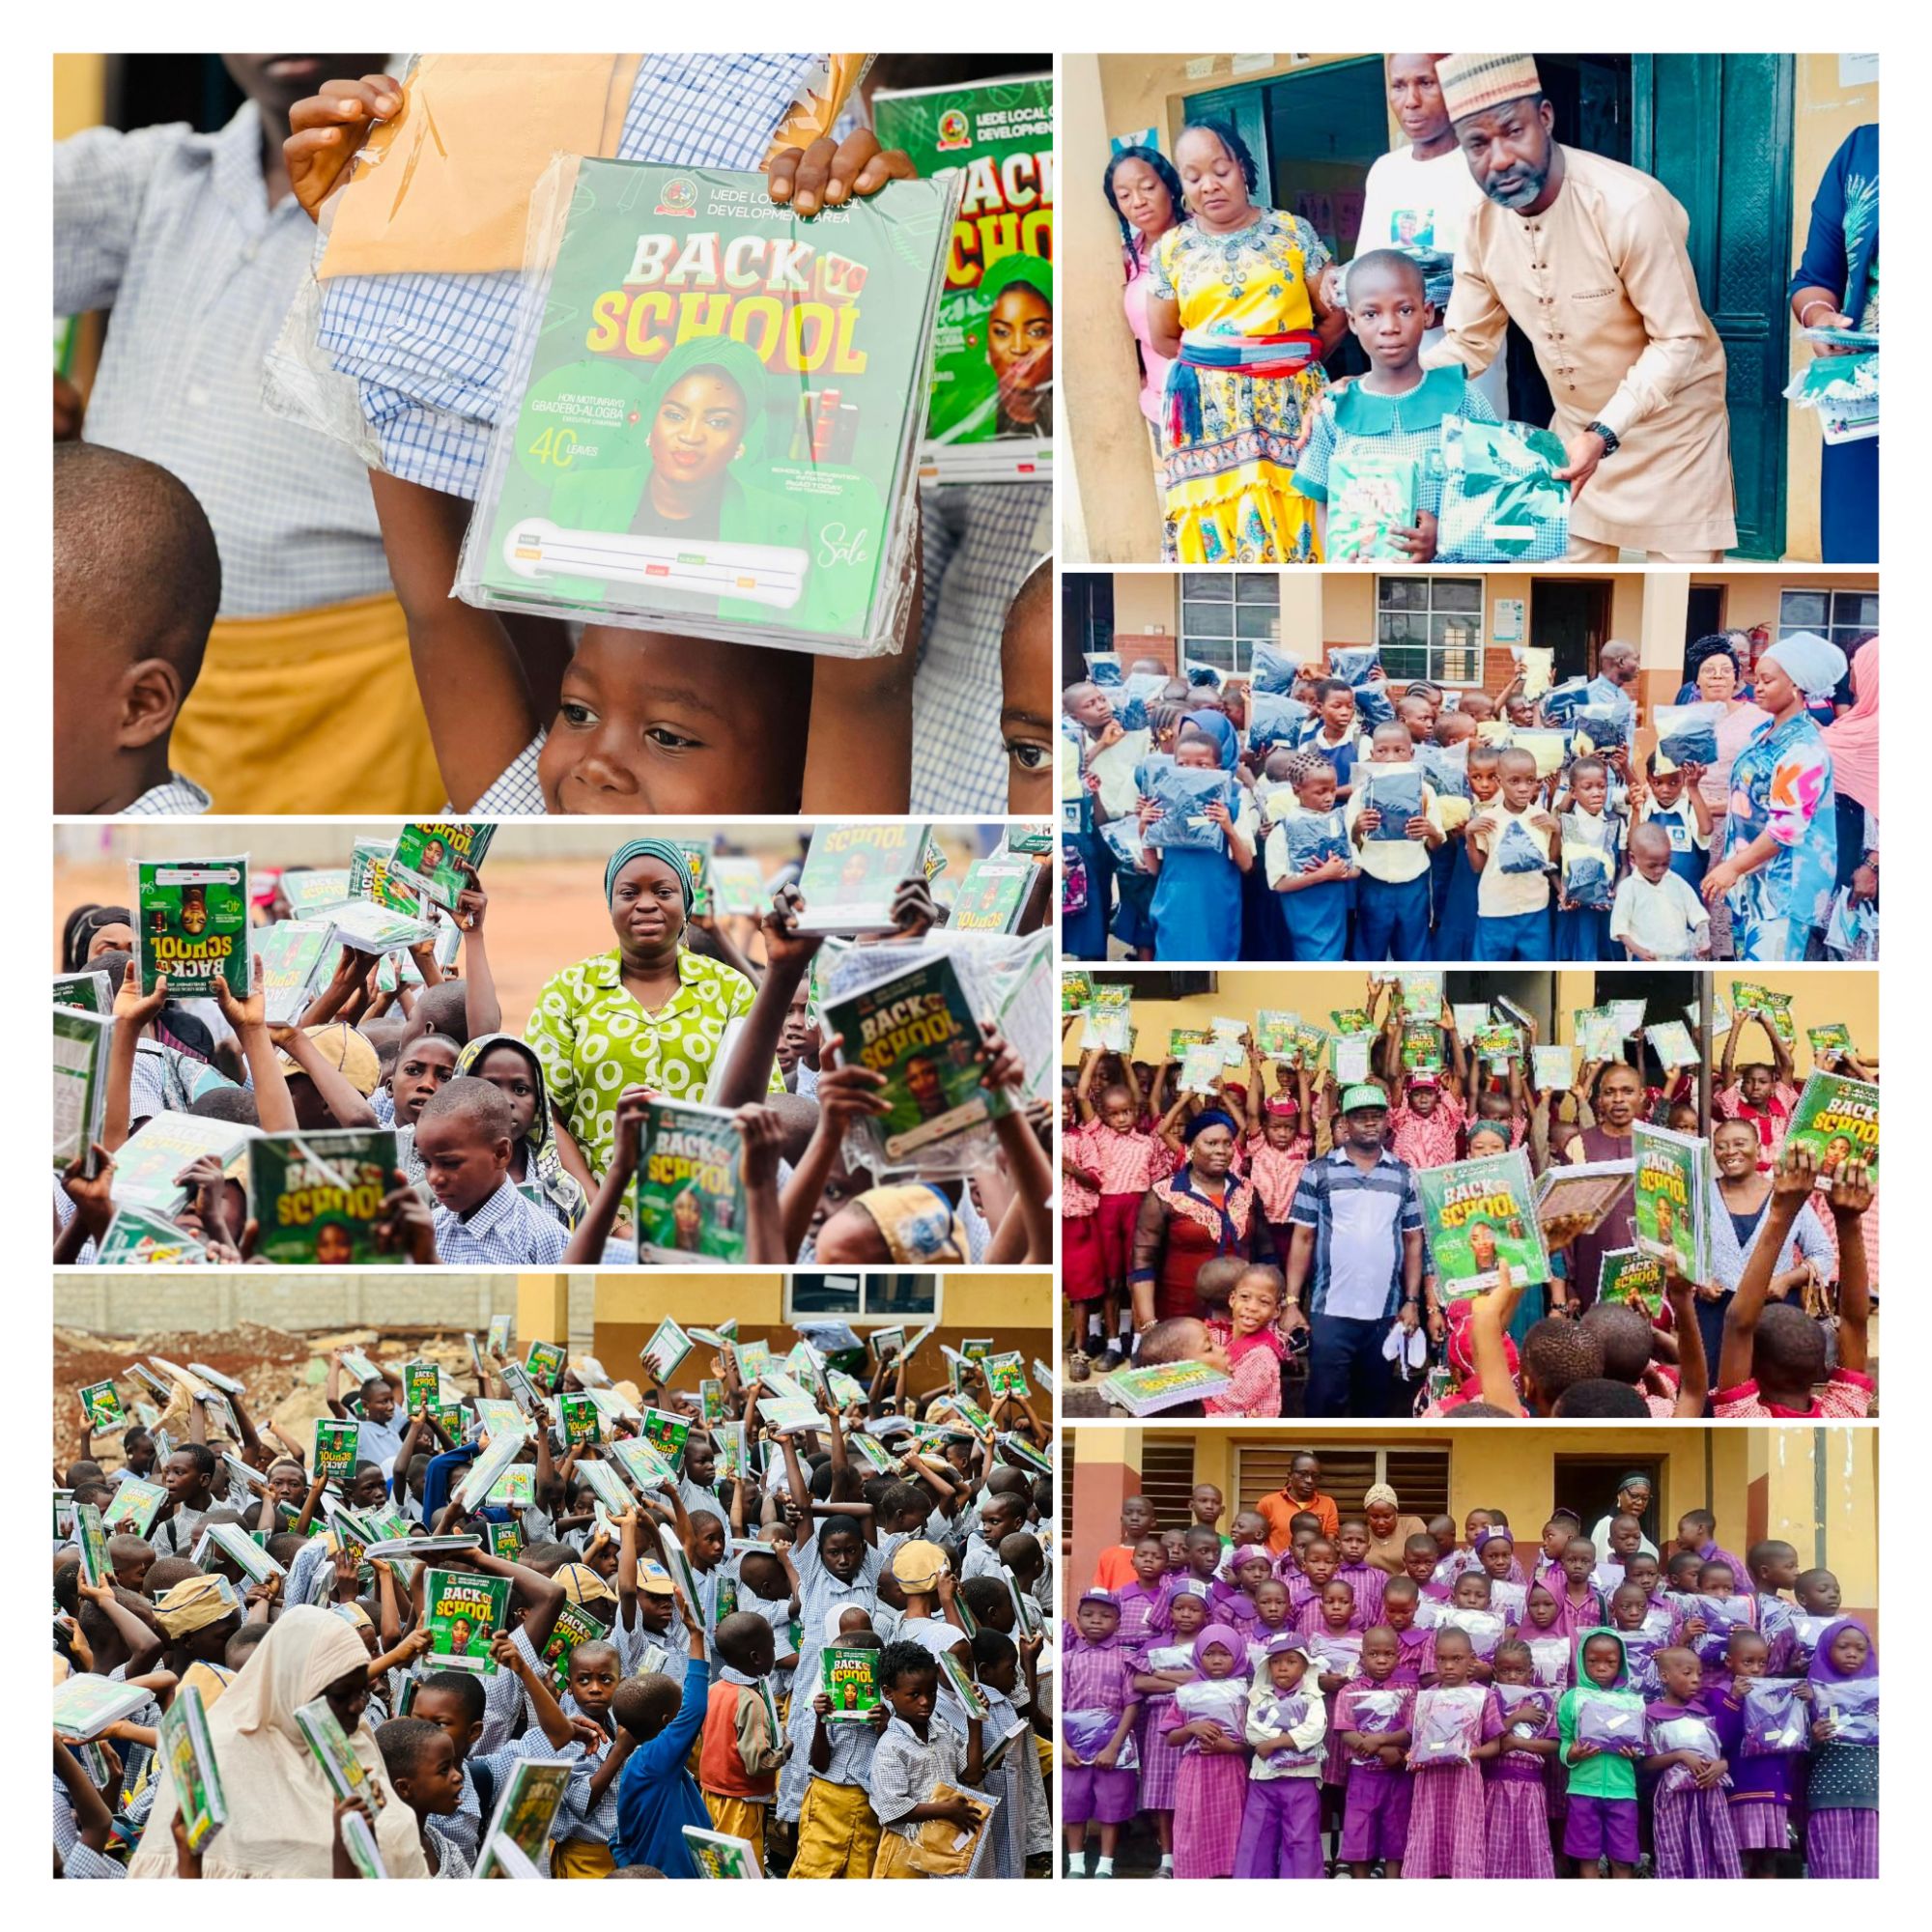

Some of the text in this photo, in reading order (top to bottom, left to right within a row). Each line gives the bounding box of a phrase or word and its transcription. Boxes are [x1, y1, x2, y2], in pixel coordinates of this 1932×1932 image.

[976, 107, 1046, 127] IJEDE LOCAL
[710, 188, 749, 203] IJEDE
[812, 212, 851, 224] AREA
[622, 232, 868, 298] BACK TO
[585, 289, 868, 375] SCHOOL
[528, 426, 599, 468] 40 LEAVES
[817, 522, 868, 568] Sale
[822, 825, 908, 853] SCHOOL
[150, 935, 233, 959] SCHOOL
[172, 956, 225, 979] BACK
[860, 994, 924, 1045] BACK
[861, 1009, 963, 1071] SCHOOL
[1826, 1097, 1871, 1122] BACK
[656, 1131, 713, 1161] BACK
[648, 1153, 736, 1197] SCHOOL
[1640, 1168, 1689, 1206] SCHOOL
[1443, 1179, 1496, 1208] BACK
[1439, 1192, 1520, 1230] SCHOOL
[1614, 1269, 1661, 1289] SCHOOL
[1620, 1260, 1652, 1278] BACK
[320, 1450, 353, 1463] SCHOOL
[442, 1586, 482, 1603] BACK
[436, 1600, 495, 1621] SCHOOL
[557, 1610, 586, 1634] BACK
[830, 1668, 874, 1683] SCHOOL
[834, 1659, 863, 1670] BACK
